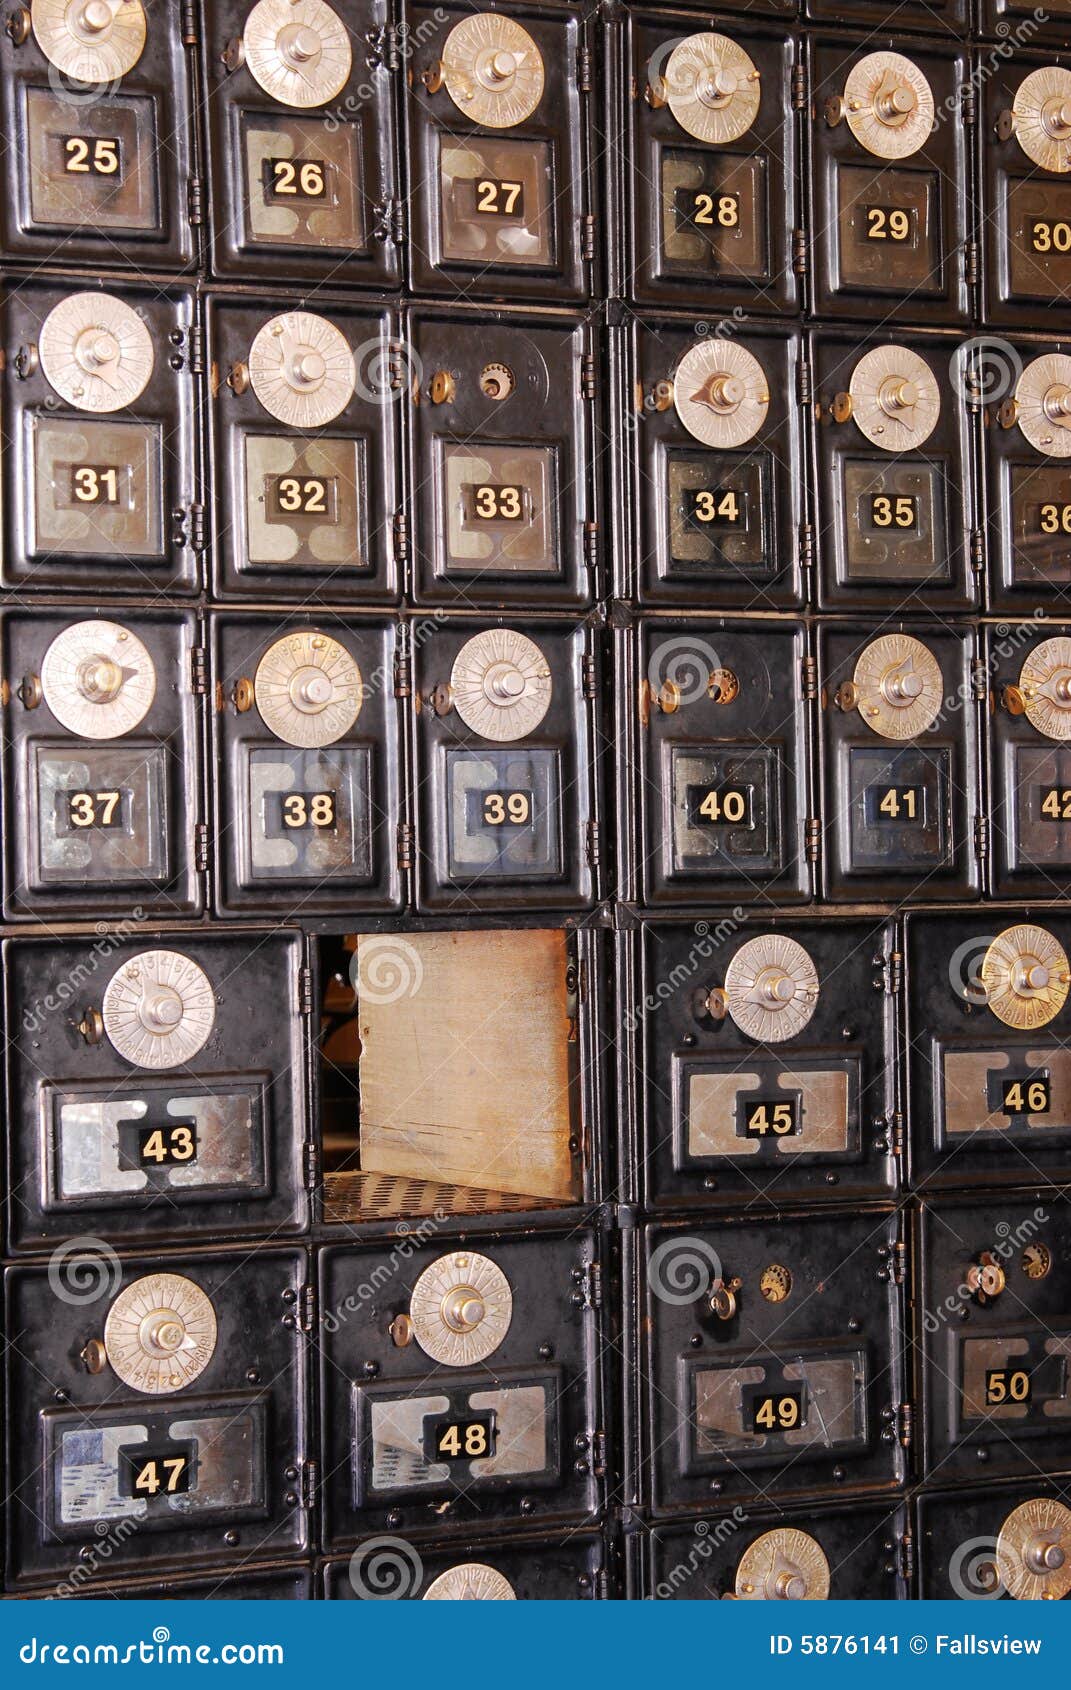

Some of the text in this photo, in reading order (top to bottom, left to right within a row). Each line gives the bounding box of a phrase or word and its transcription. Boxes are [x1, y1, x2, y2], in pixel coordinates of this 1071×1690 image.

[66, 138, 118, 174] 25
[274, 162, 324, 196] 26
[477, 181, 521, 214] 27
[694, 194, 738, 227] 28
[868, 209, 909, 240] 29
[1033, 222, 1071, 252] 30
[74, 467, 118, 502] 31
[279, 479, 326, 512] 32
[476, 487, 521, 518] 33
[695, 491, 739, 522] 34
[873, 497, 914, 527] 35
[70, 792, 120, 827] 37
[284, 794, 334, 827] 38
[484, 793, 529, 825] 39
[699, 791, 745, 822] 40
[880, 789, 915, 818] 41
[1005, 1082, 1047, 1111] 46
[748, 1104, 792, 1134] 45
[143, 1127, 194, 1162] 43
[988, 1372, 1029, 1402] 50
[756, 1397, 798, 1428] 49
[439, 1424, 487, 1456] 48
[135, 1458, 185, 1494] 47
